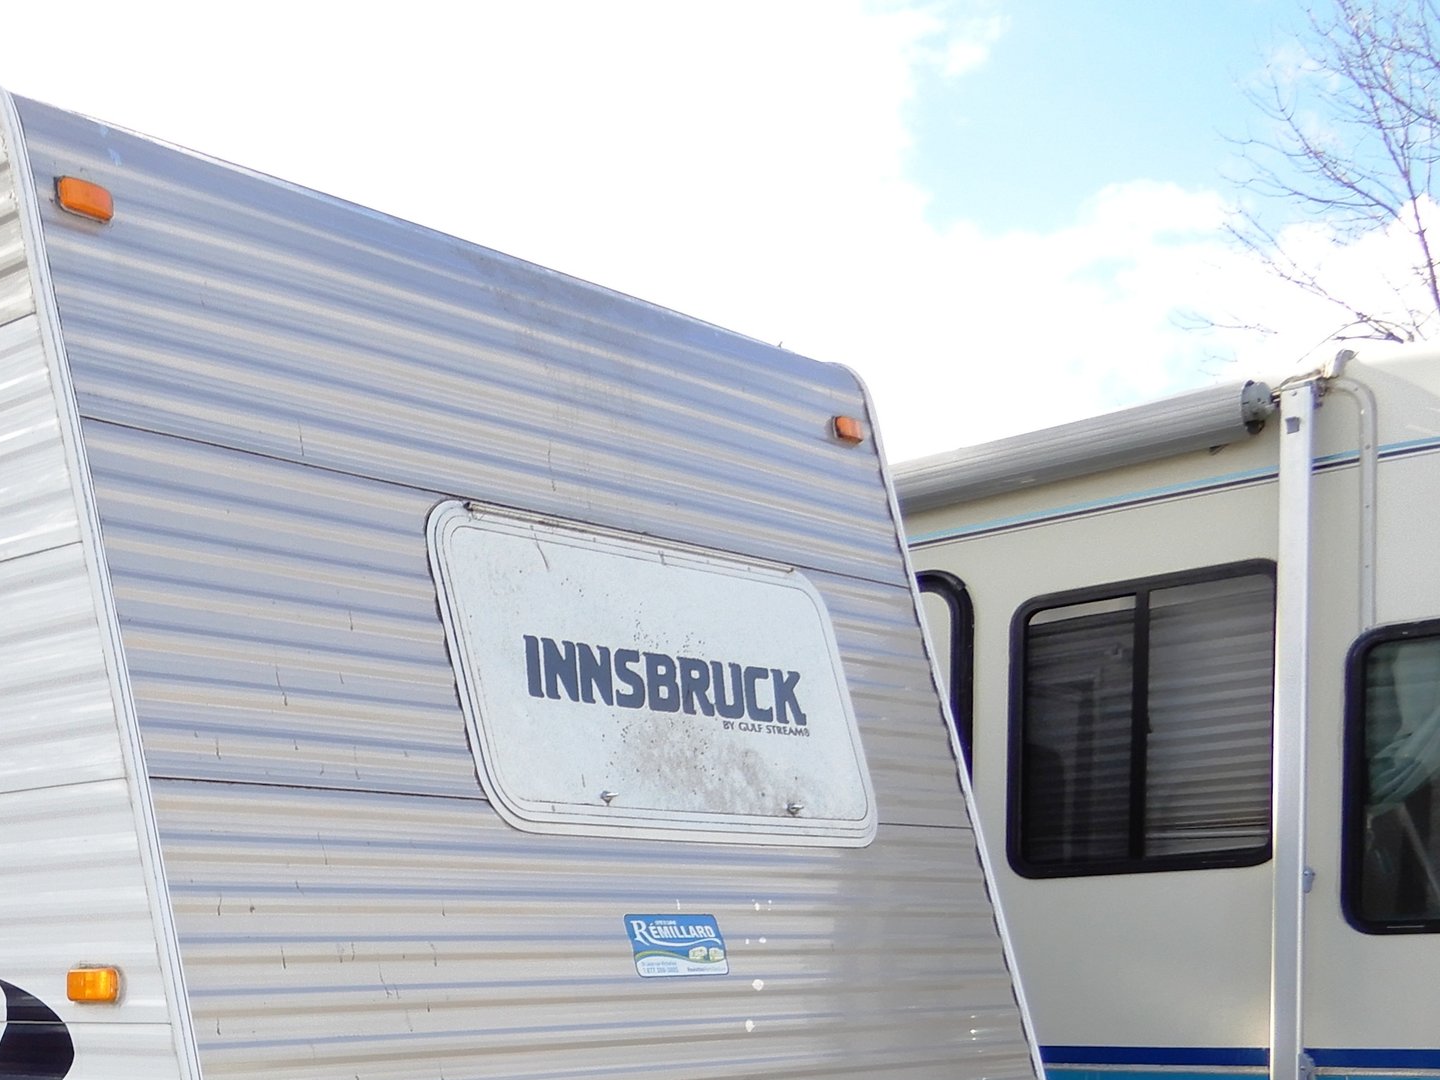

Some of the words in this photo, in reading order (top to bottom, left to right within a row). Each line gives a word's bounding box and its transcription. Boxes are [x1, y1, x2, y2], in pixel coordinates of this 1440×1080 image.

[522, 634, 808, 726] INNSBRUCK
[723, 720, 735, 731] BY
[738, 721, 763, 733] GULF
[630, 920, 716, 942] RÉMILLARD
